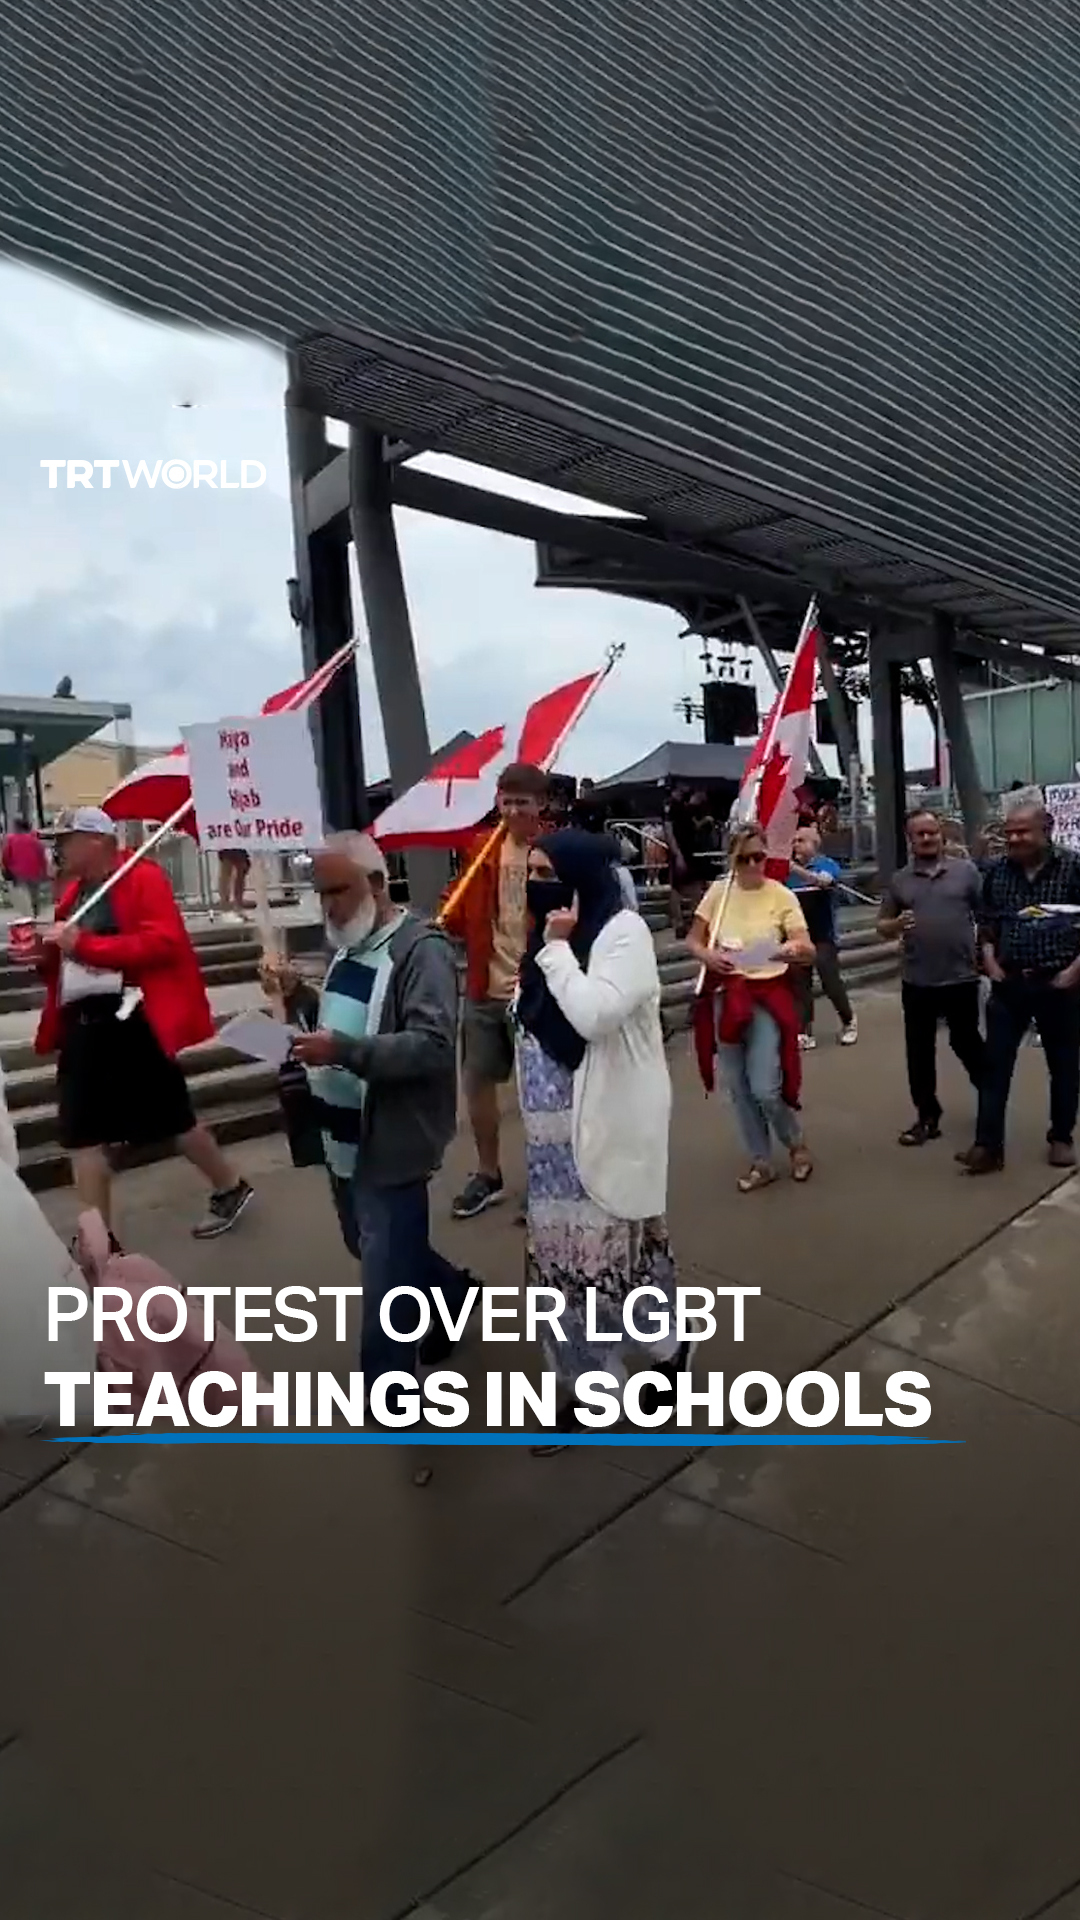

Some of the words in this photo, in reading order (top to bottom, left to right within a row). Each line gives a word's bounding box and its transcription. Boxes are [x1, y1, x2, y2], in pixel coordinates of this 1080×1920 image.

[207, 823, 232, 840] are
[234, 819, 250, 837] Our
[255, 818, 303, 837] Pride
